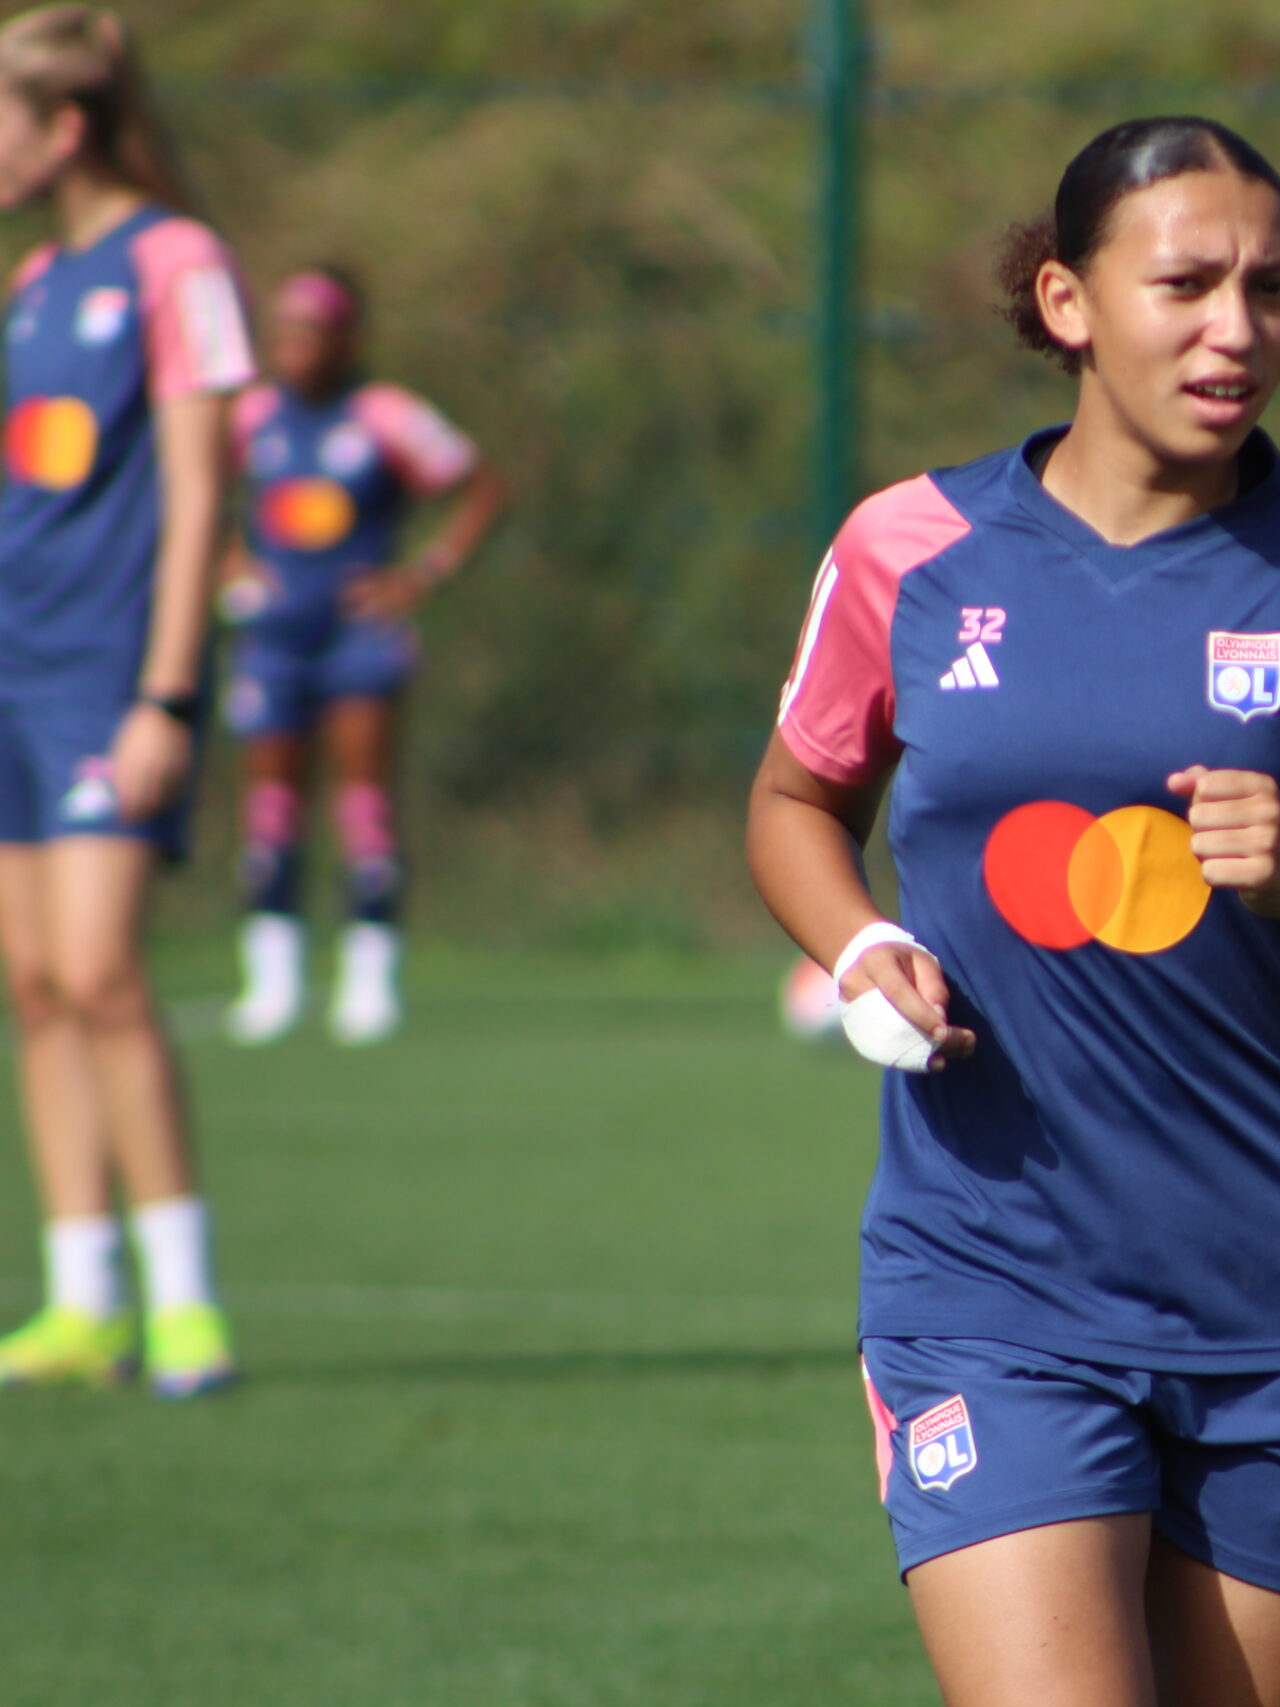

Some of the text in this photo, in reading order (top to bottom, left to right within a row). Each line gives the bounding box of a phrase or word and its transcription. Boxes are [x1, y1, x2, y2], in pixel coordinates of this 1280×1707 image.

[959, 607, 1006, 641] 32
[1217, 638, 1277, 649] OLYMPIQUE
[1217, 649, 1277, 660] LYONNAIS
[1217, 667, 1273, 702] OL
[915, 1402, 961, 1433] OLYMPIQUE
[916, 1412, 964, 1443] LYONNAIS
[917, 1434, 968, 1477] OL
